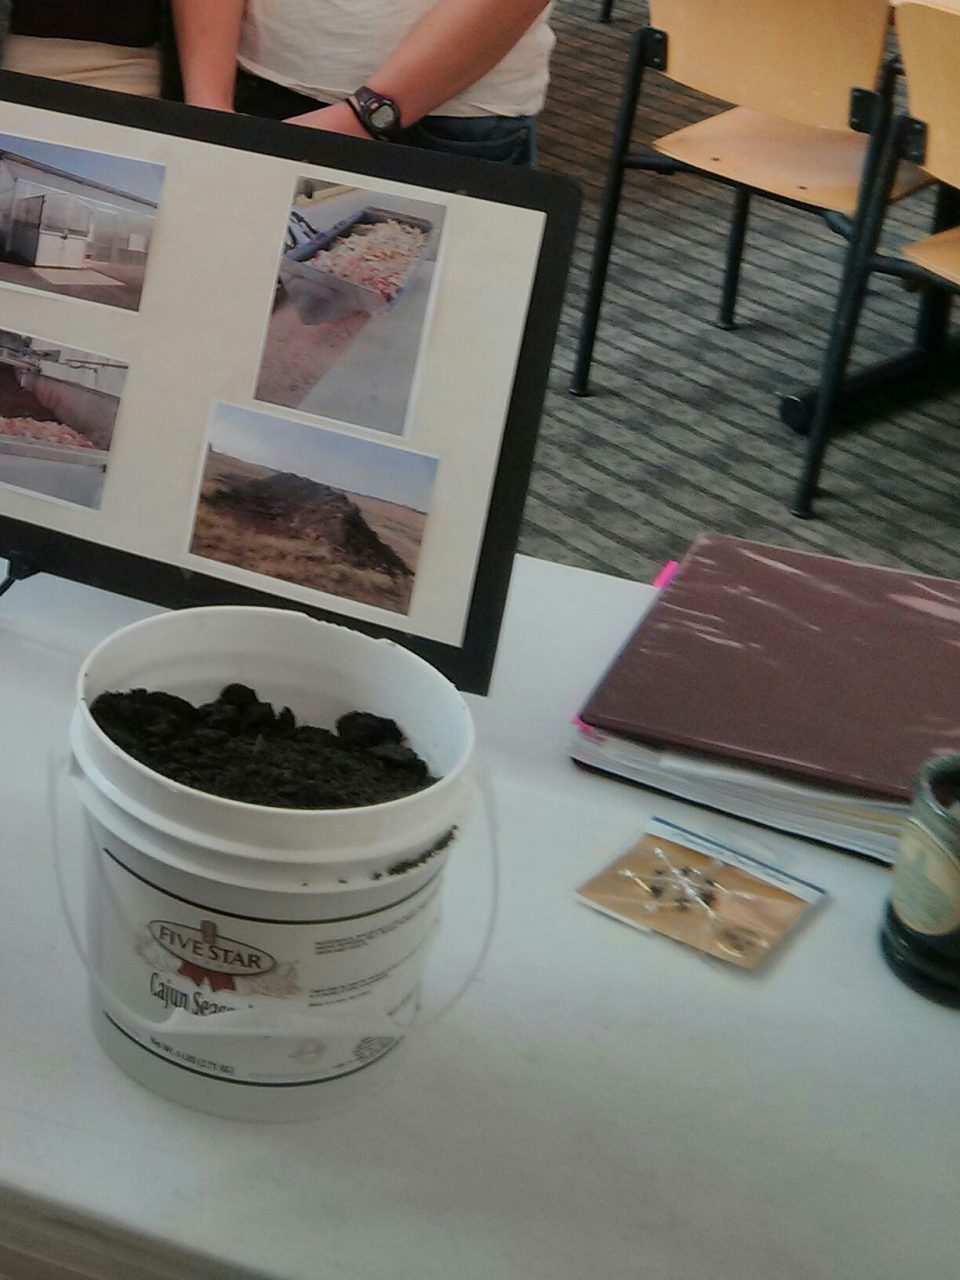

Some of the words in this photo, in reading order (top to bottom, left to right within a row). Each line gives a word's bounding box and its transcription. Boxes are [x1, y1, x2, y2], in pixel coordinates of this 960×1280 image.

[159, 925, 204, 957] FIVE
[208, 945, 262, 969] STAR
[150, 972, 189, 1009] Cajun
